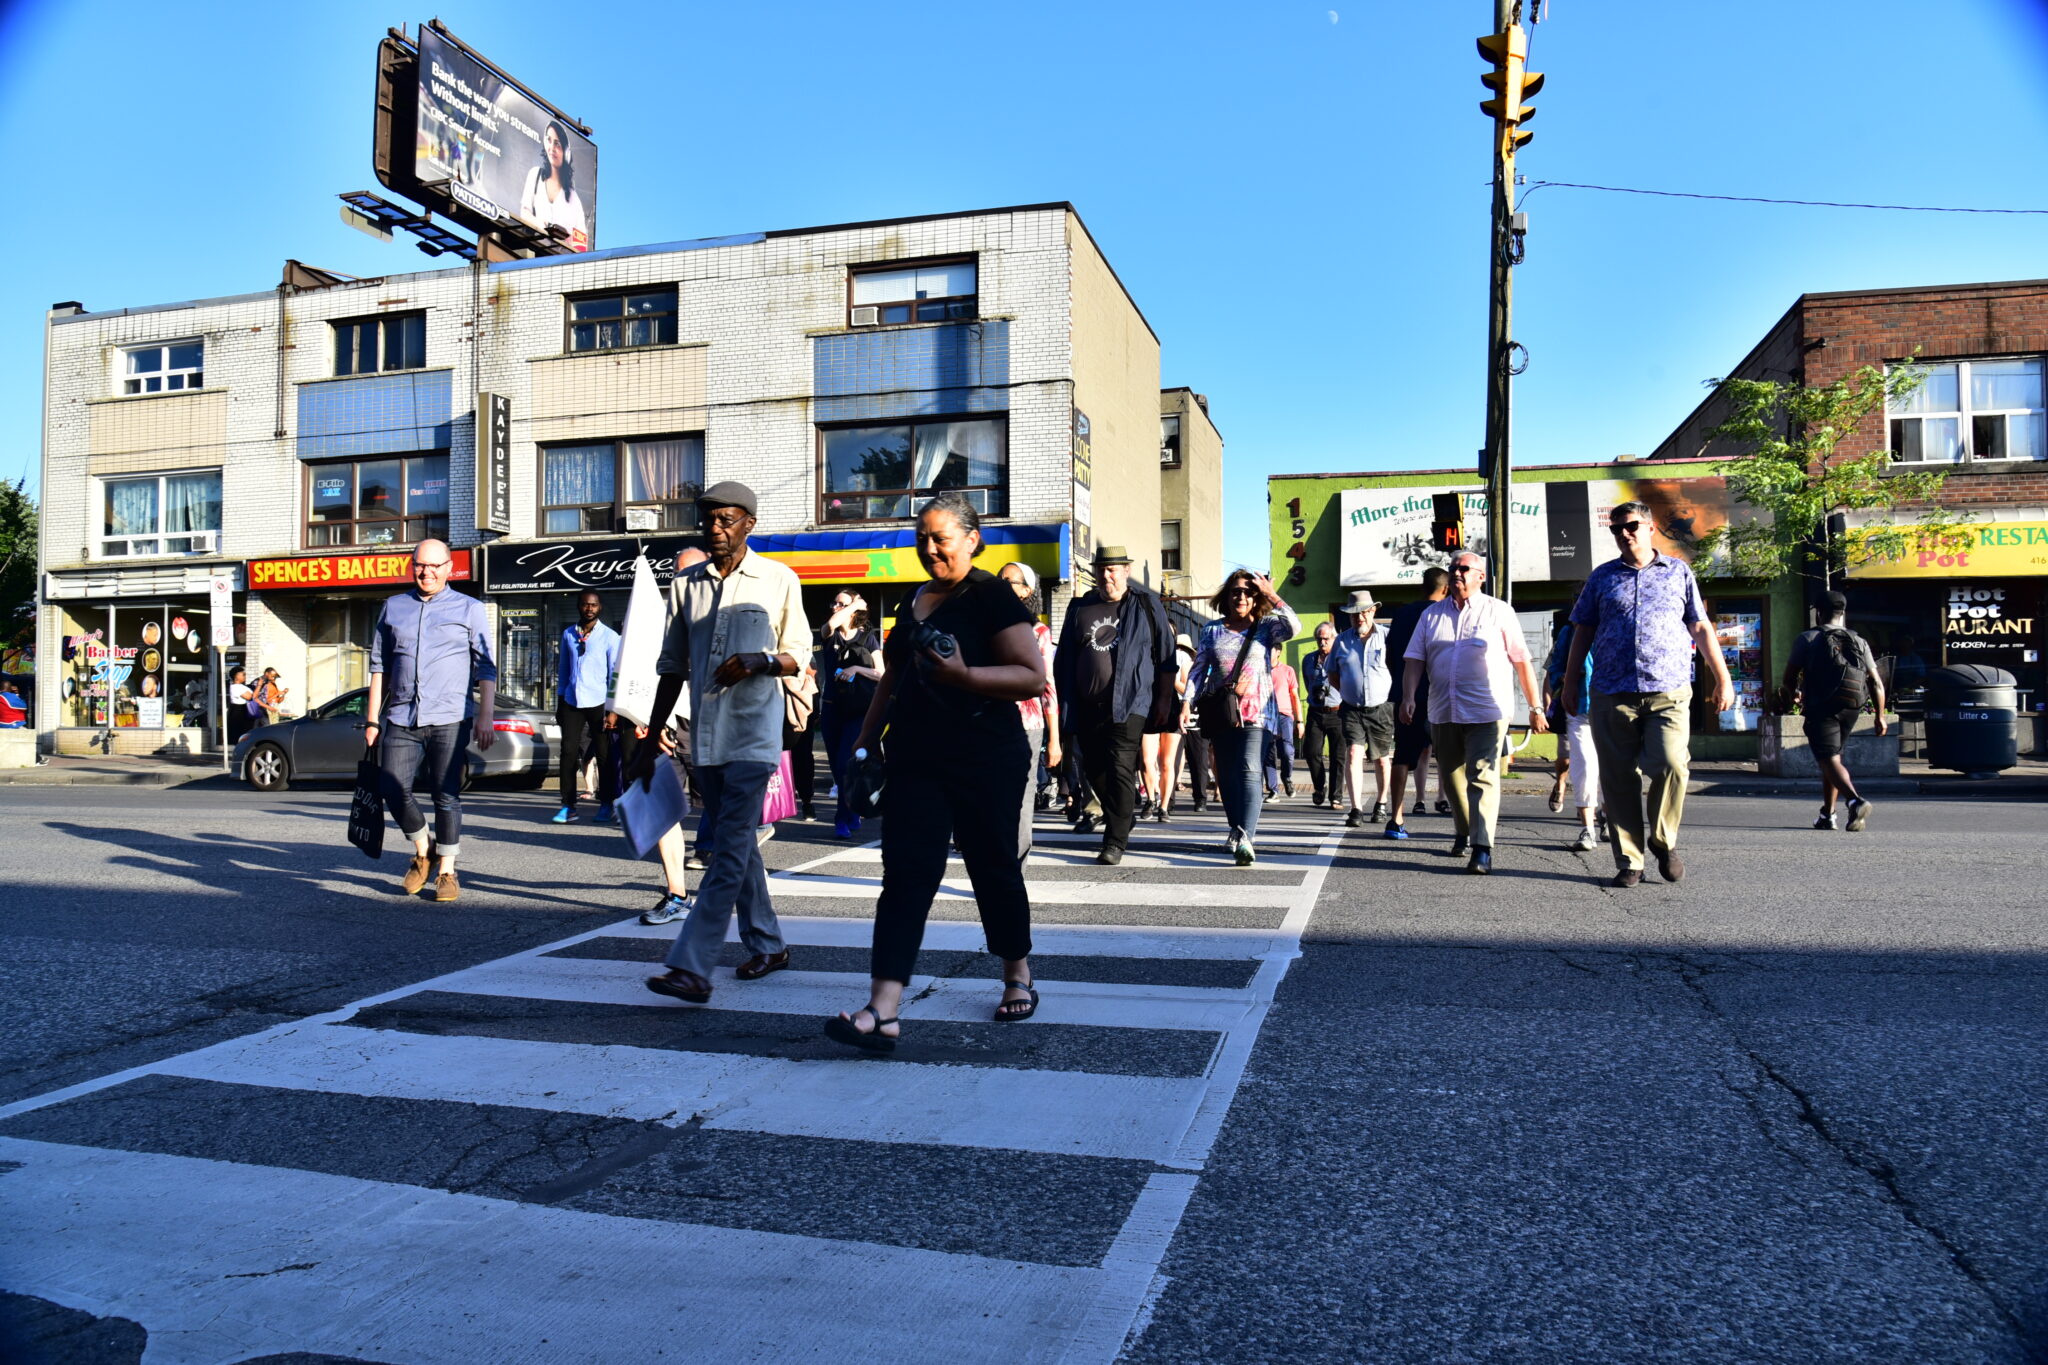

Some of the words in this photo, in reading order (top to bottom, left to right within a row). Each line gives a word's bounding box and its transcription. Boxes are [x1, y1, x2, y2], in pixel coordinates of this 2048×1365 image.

[431, 80, 471, 116] Without
[432, 61, 457, 88] Bank
[457, 79, 473, 99] the
[473, 91, 493, 114] way
[493, 103, 510, 123] you
[510, 116, 541, 144] stream.
[454, 184, 496, 217] PATTISON
[496, 397, 507, 511] KAYDEES
[322, 488, 341, 497] TAX
[1350, 505, 1400, 527] More
[1402, 495, 1433, 512] tha
[1980, 527, 2048, 545] RESTA
[516, 544, 680, 587] Kaydee
[1917, 550, 1969, 567] Pot
[254, 558, 332, 583] SPENCE'S
[337, 556, 411, 580] BAKERY
[1948, 586, 2006, 601] Hot
[1948, 602, 2001, 618] Pot
[1946, 618, 2034, 635] AURANT
[1951, 641, 1987, 649] CHICKEN
[1958, 711, 1979, 720] Litter
